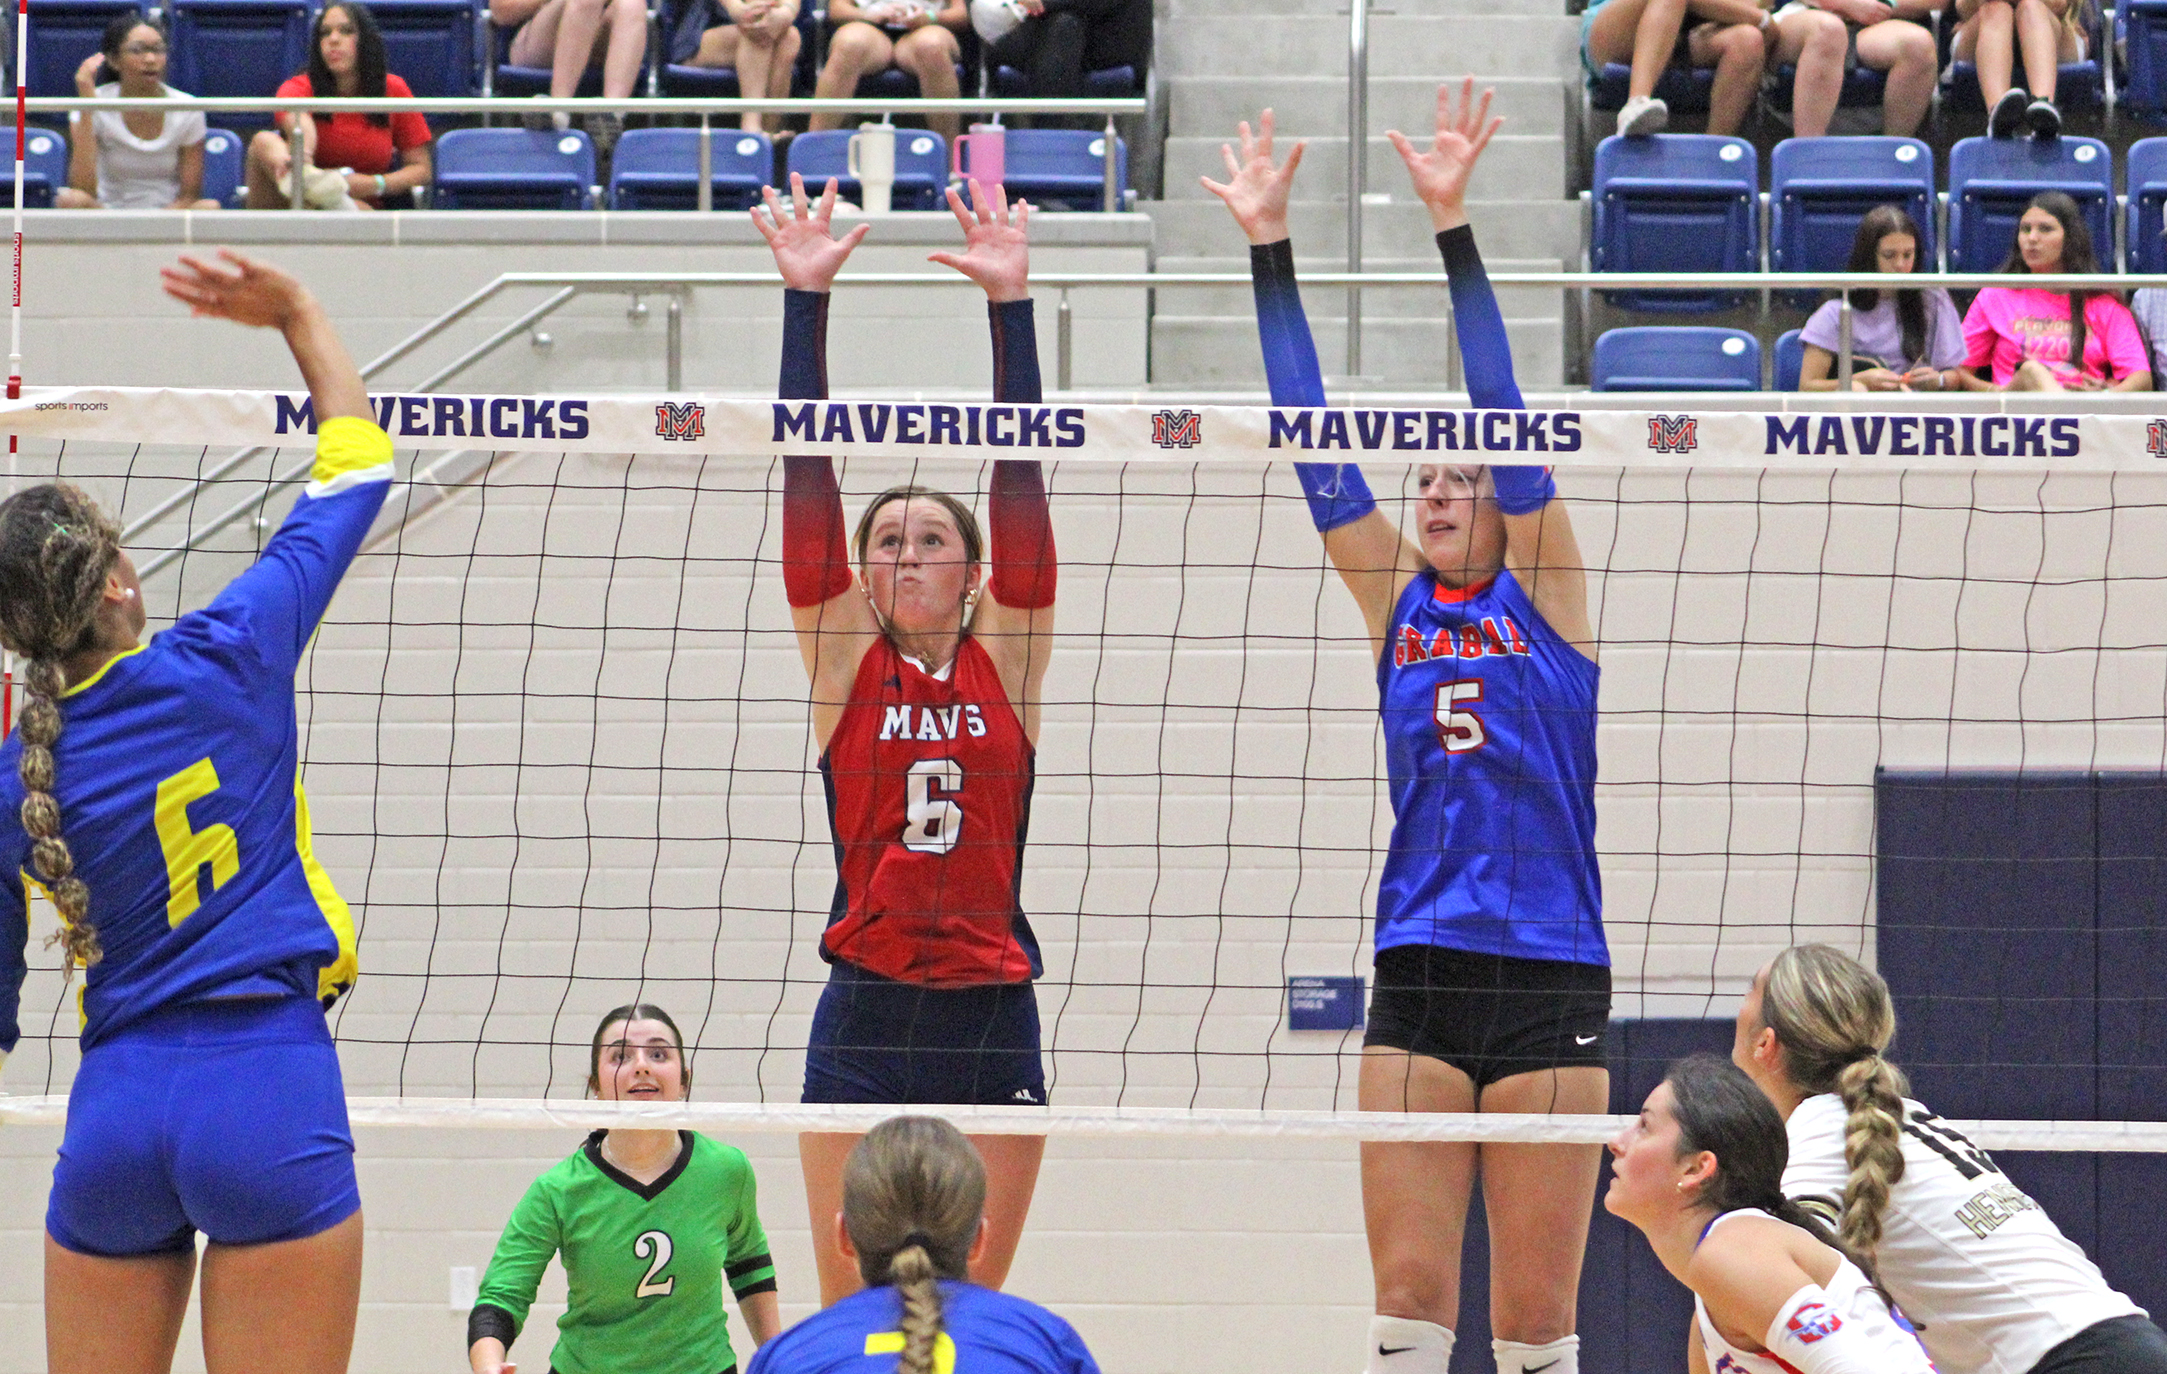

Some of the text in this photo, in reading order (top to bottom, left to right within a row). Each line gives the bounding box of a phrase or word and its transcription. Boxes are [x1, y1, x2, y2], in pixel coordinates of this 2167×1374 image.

[35, 401, 67, 411] sports
[274, 395, 589, 440] MVERICKS
[771, 403, 1085, 448] MAVERICKS
[1267, 410, 1581, 452] MAVERICKS
[1764, 415, 2079, 457] MAVERICKS
[879, 703, 987, 741] MAVS
[1433, 678, 1487, 755] 5
[902, 757, 964, 856] 6
[633, 1229, 675, 1299] 2
